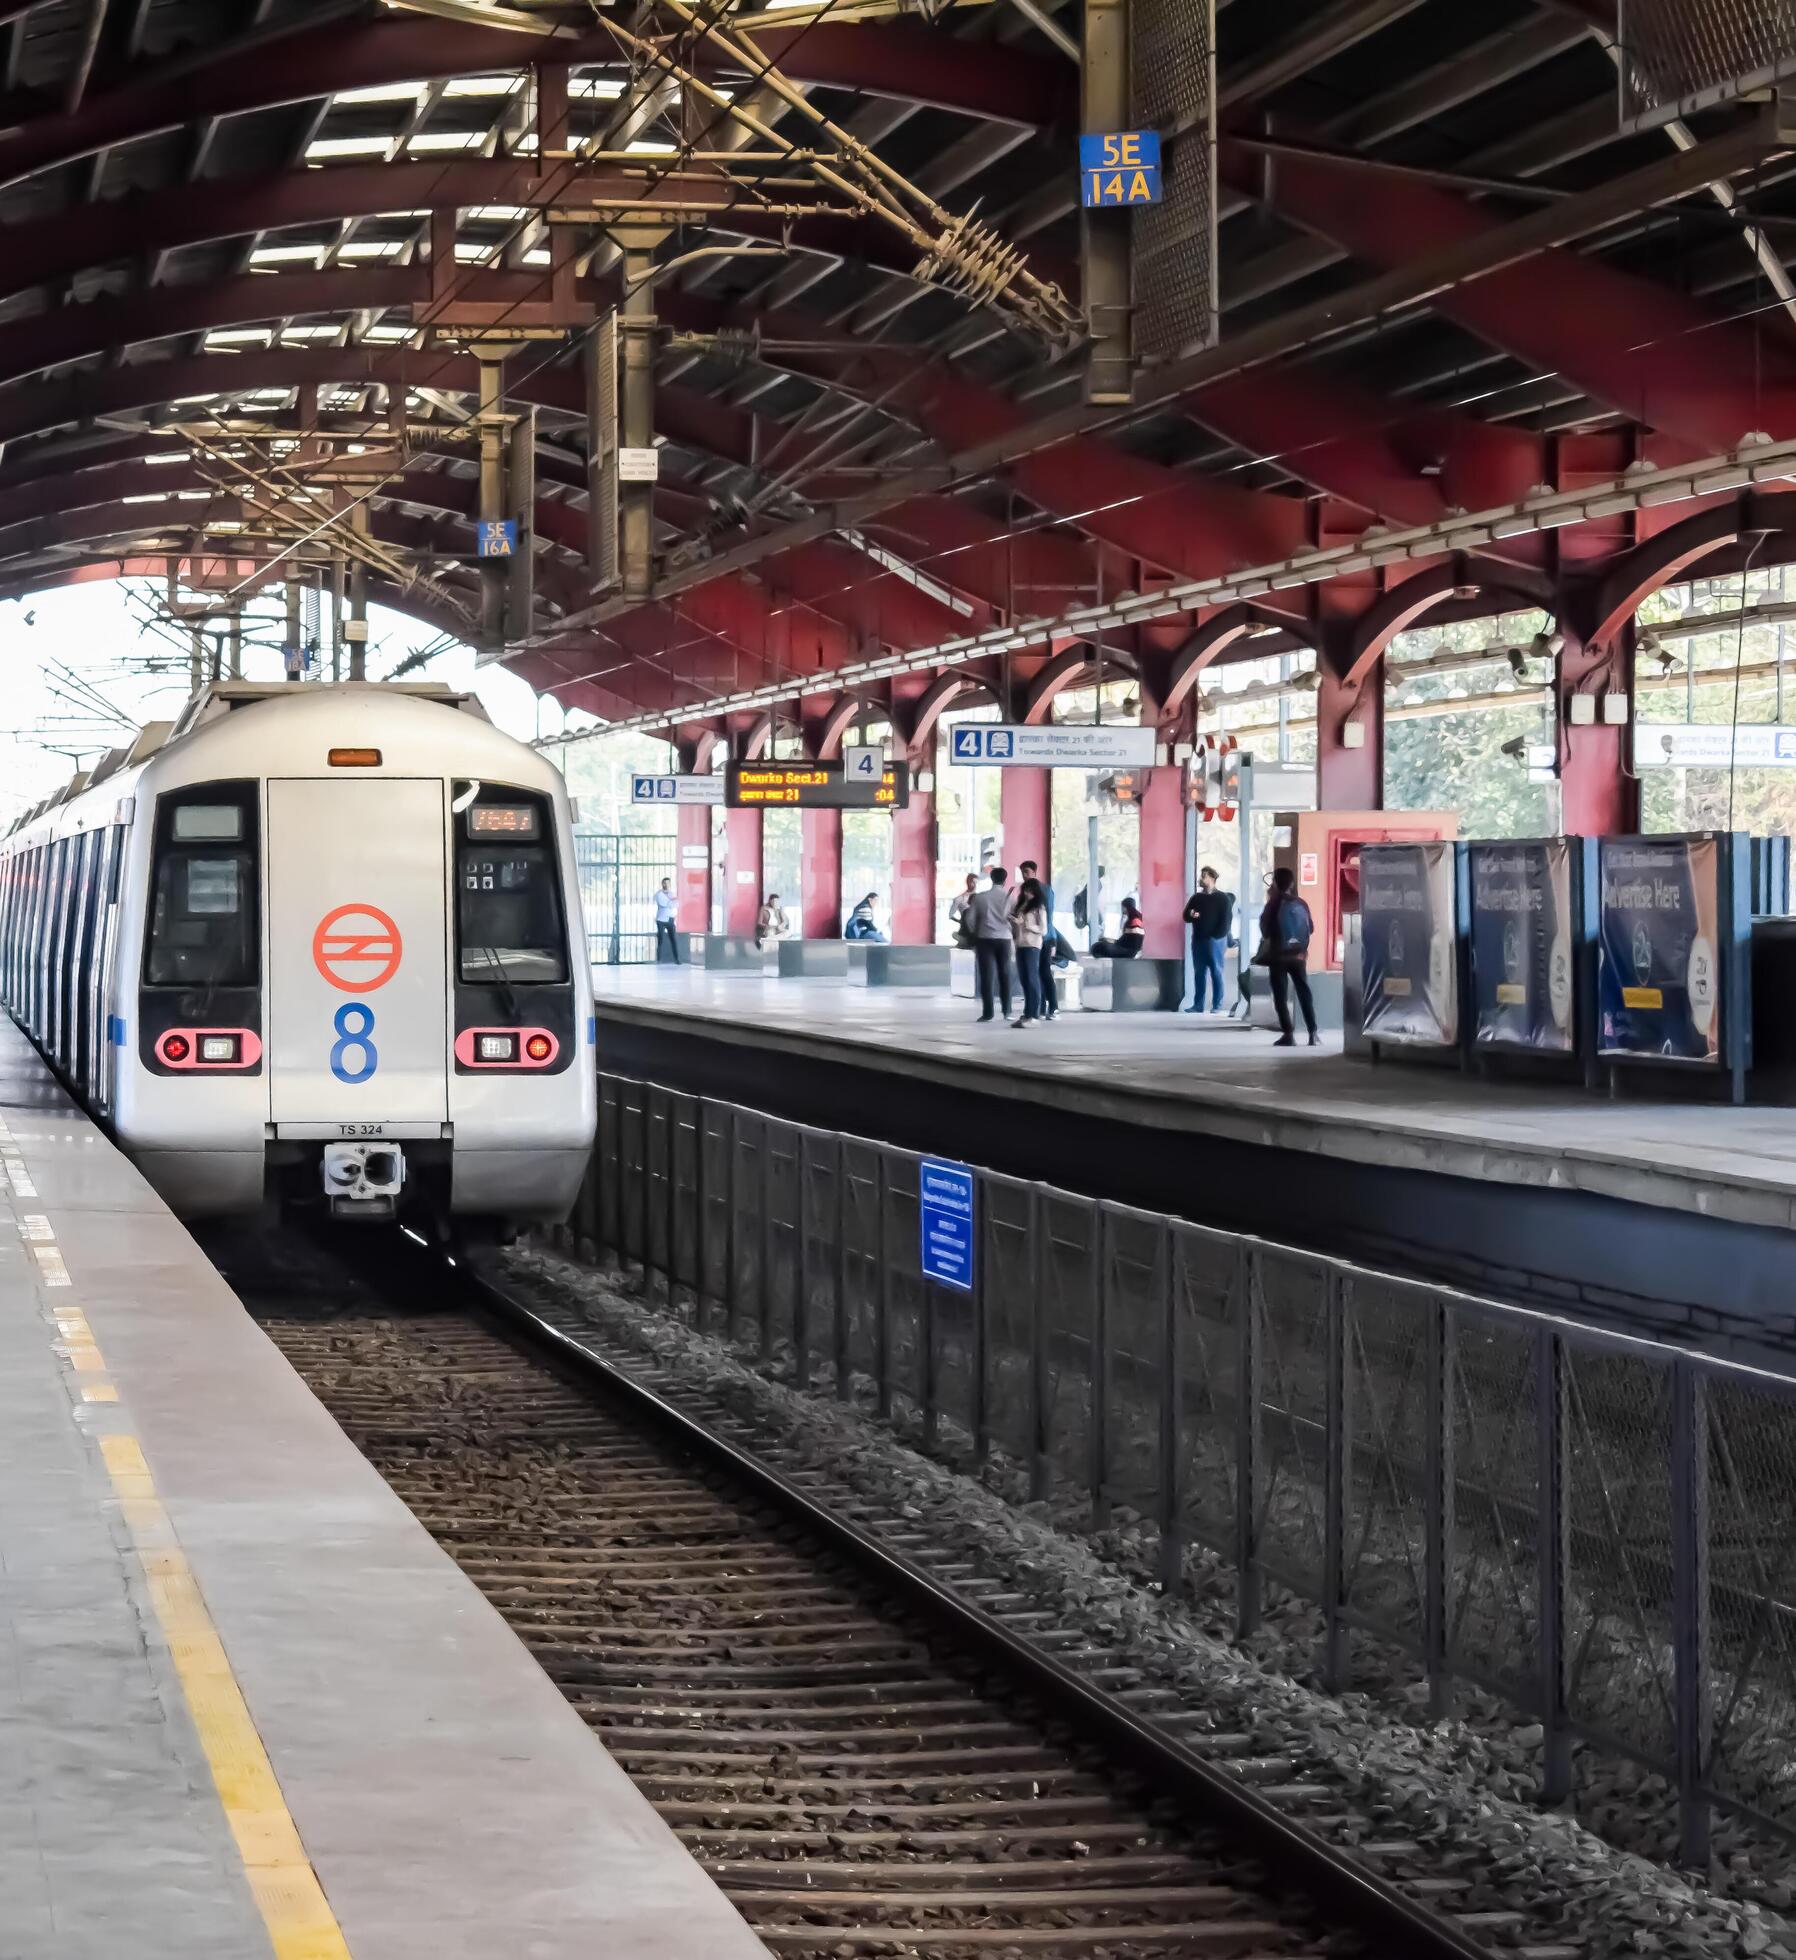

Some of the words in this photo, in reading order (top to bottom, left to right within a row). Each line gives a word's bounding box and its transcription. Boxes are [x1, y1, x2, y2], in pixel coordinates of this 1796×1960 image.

[1103, 134, 1142, 166] 5E
[1093, 171, 1152, 205] 14A
[487, 522, 506, 538] 5E
[484, 540, 512, 557] 16A
[959, 732, 978, 756] 4
[858, 754, 874, 774] 4
[740, 771, 784, 784] Dwarka
[638, 780, 652, 797] 4
[330, 1002, 378, 1084] 8
[339, 1125, 357, 1136] TS
[360, 1125, 383, 1136] 324
